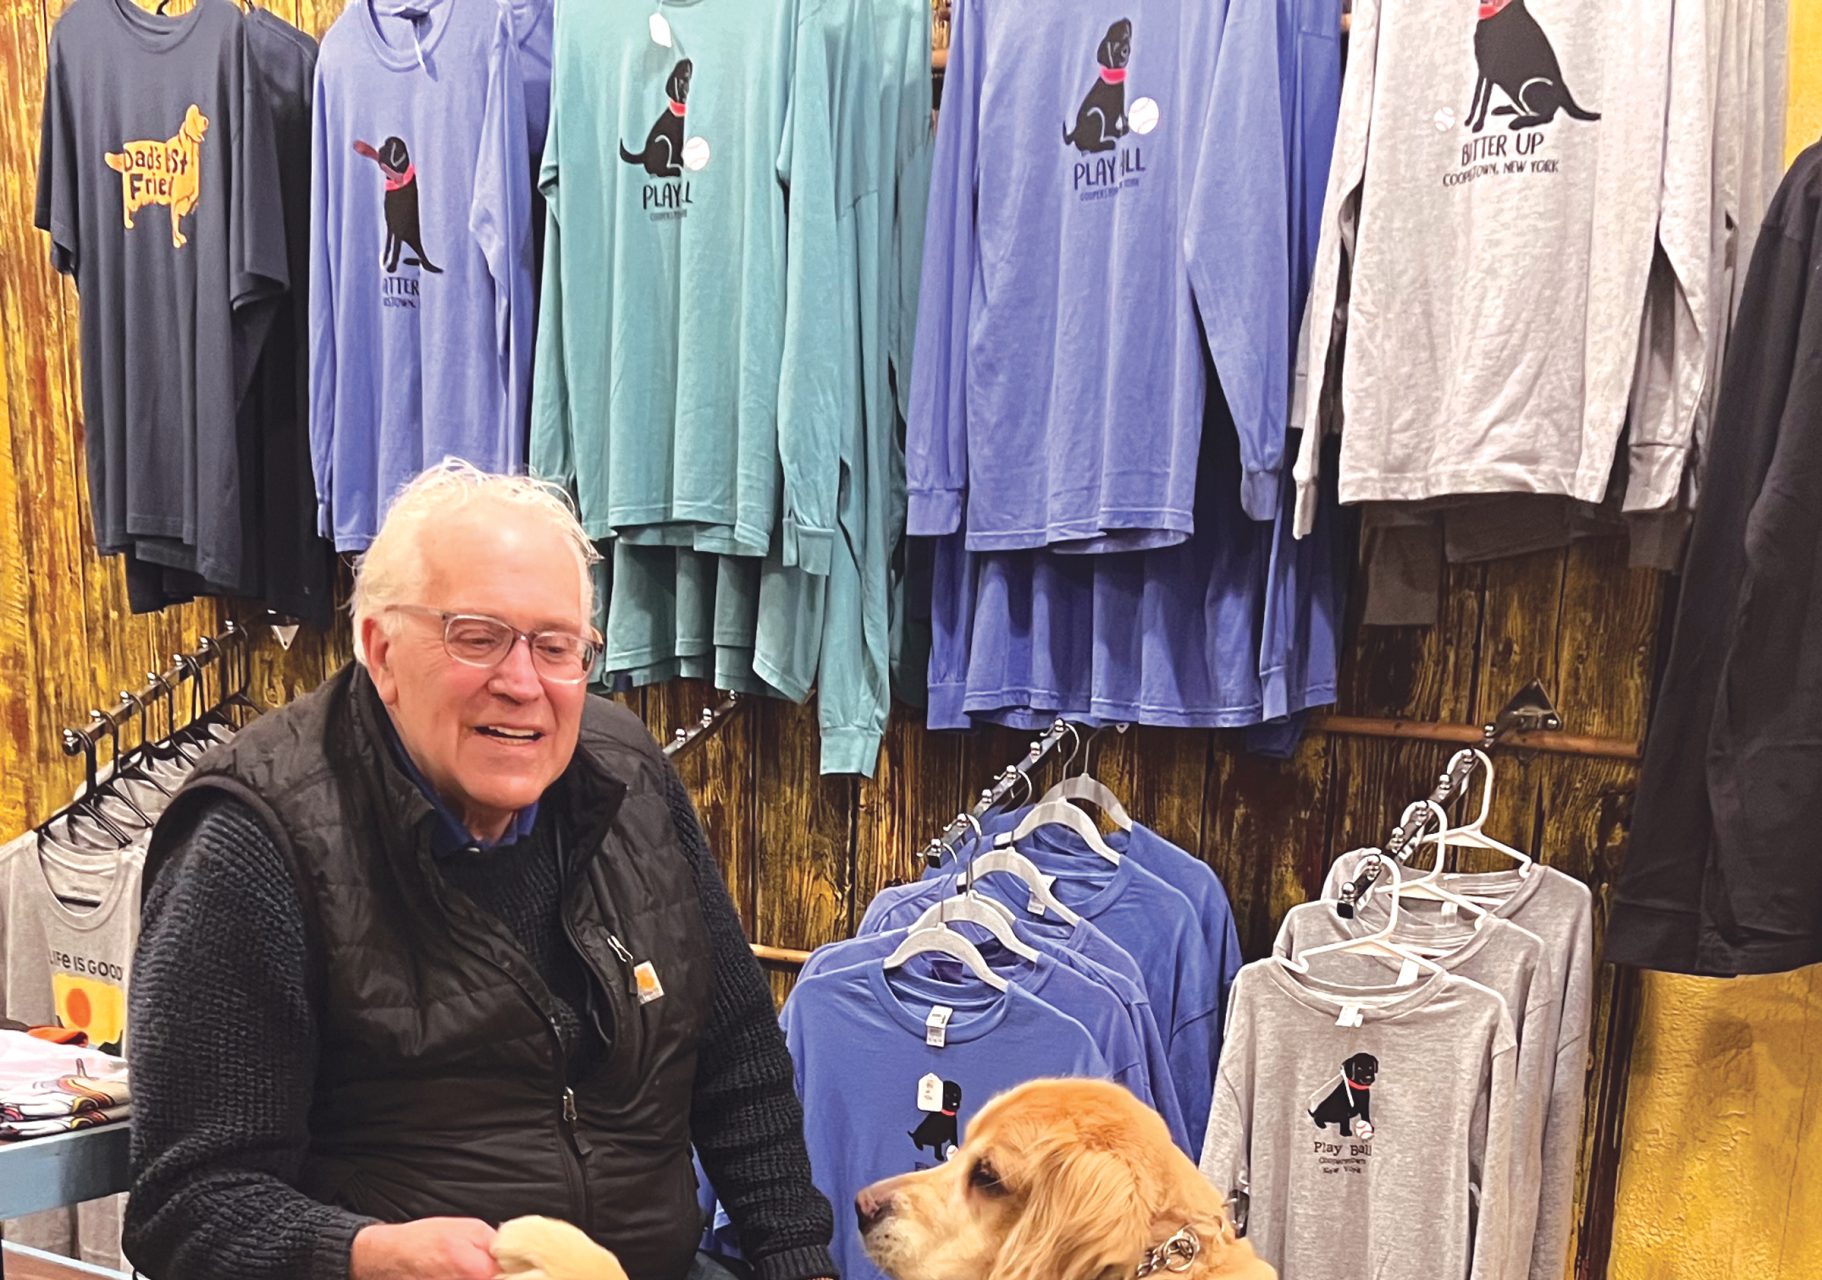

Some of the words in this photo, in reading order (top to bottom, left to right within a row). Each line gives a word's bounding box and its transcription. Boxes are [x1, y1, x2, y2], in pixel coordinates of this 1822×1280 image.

[1516, 132, 1544, 155] UP
[124, 146, 161, 172] Dad's
[1503, 160, 1527, 174] NEW
[1530, 160, 1560, 174] YORK
[1074, 156, 1116, 191] PLAY
[643, 182, 682, 210] PLAY
[73, 955, 85, 972] IS
[87, 959, 123, 981] GOOD
[1314, 1141, 1342, 1156] Play
[1350, 1144, 1372, 1156] Ball
